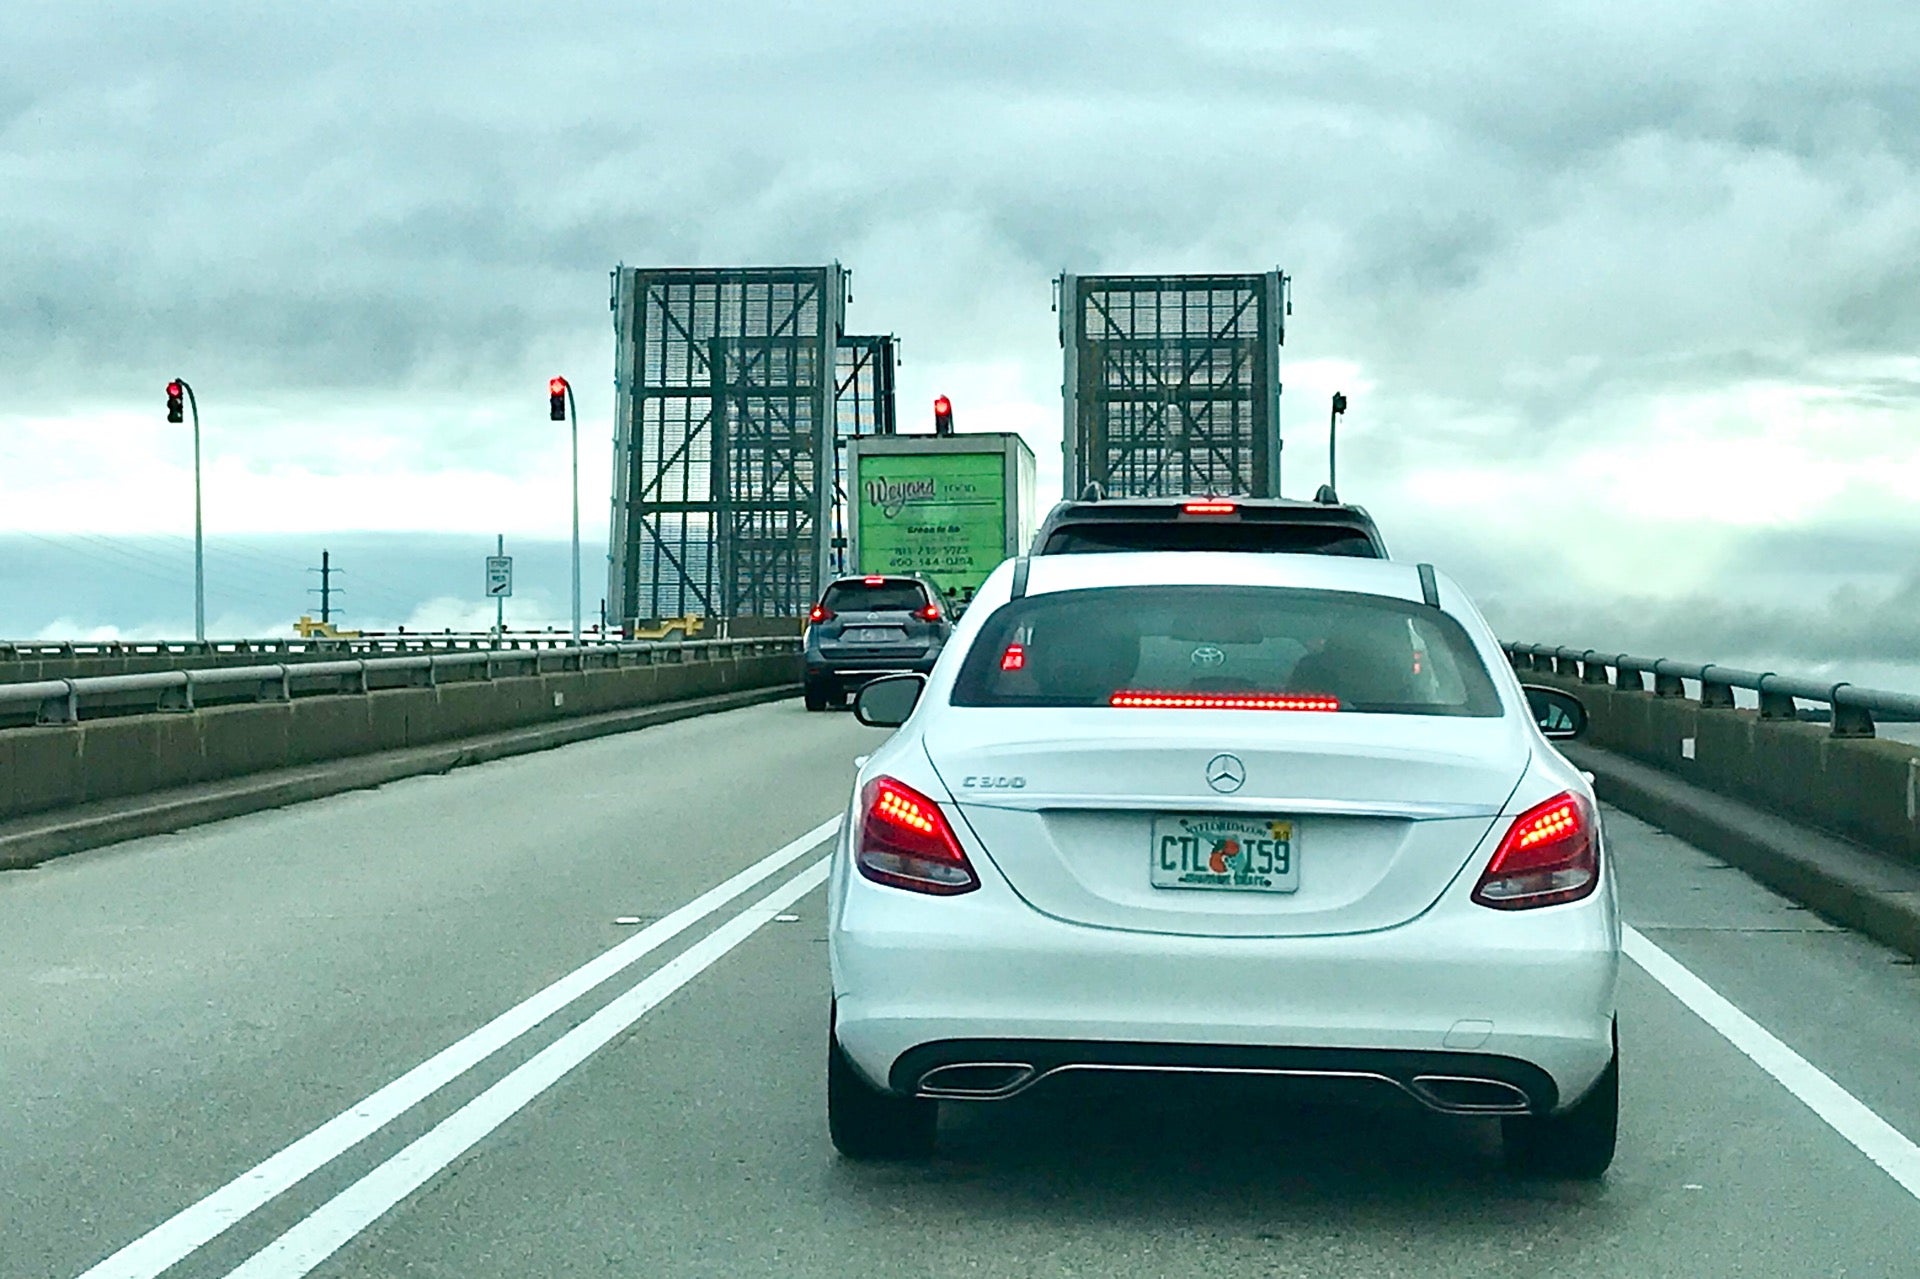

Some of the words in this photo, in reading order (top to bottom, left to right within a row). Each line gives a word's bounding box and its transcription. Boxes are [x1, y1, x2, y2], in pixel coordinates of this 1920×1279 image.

[866, 476, 935, 518] Weyand
[962, 776, 1026, 789] C300
[1161, 835, 1208, 872] CTL
